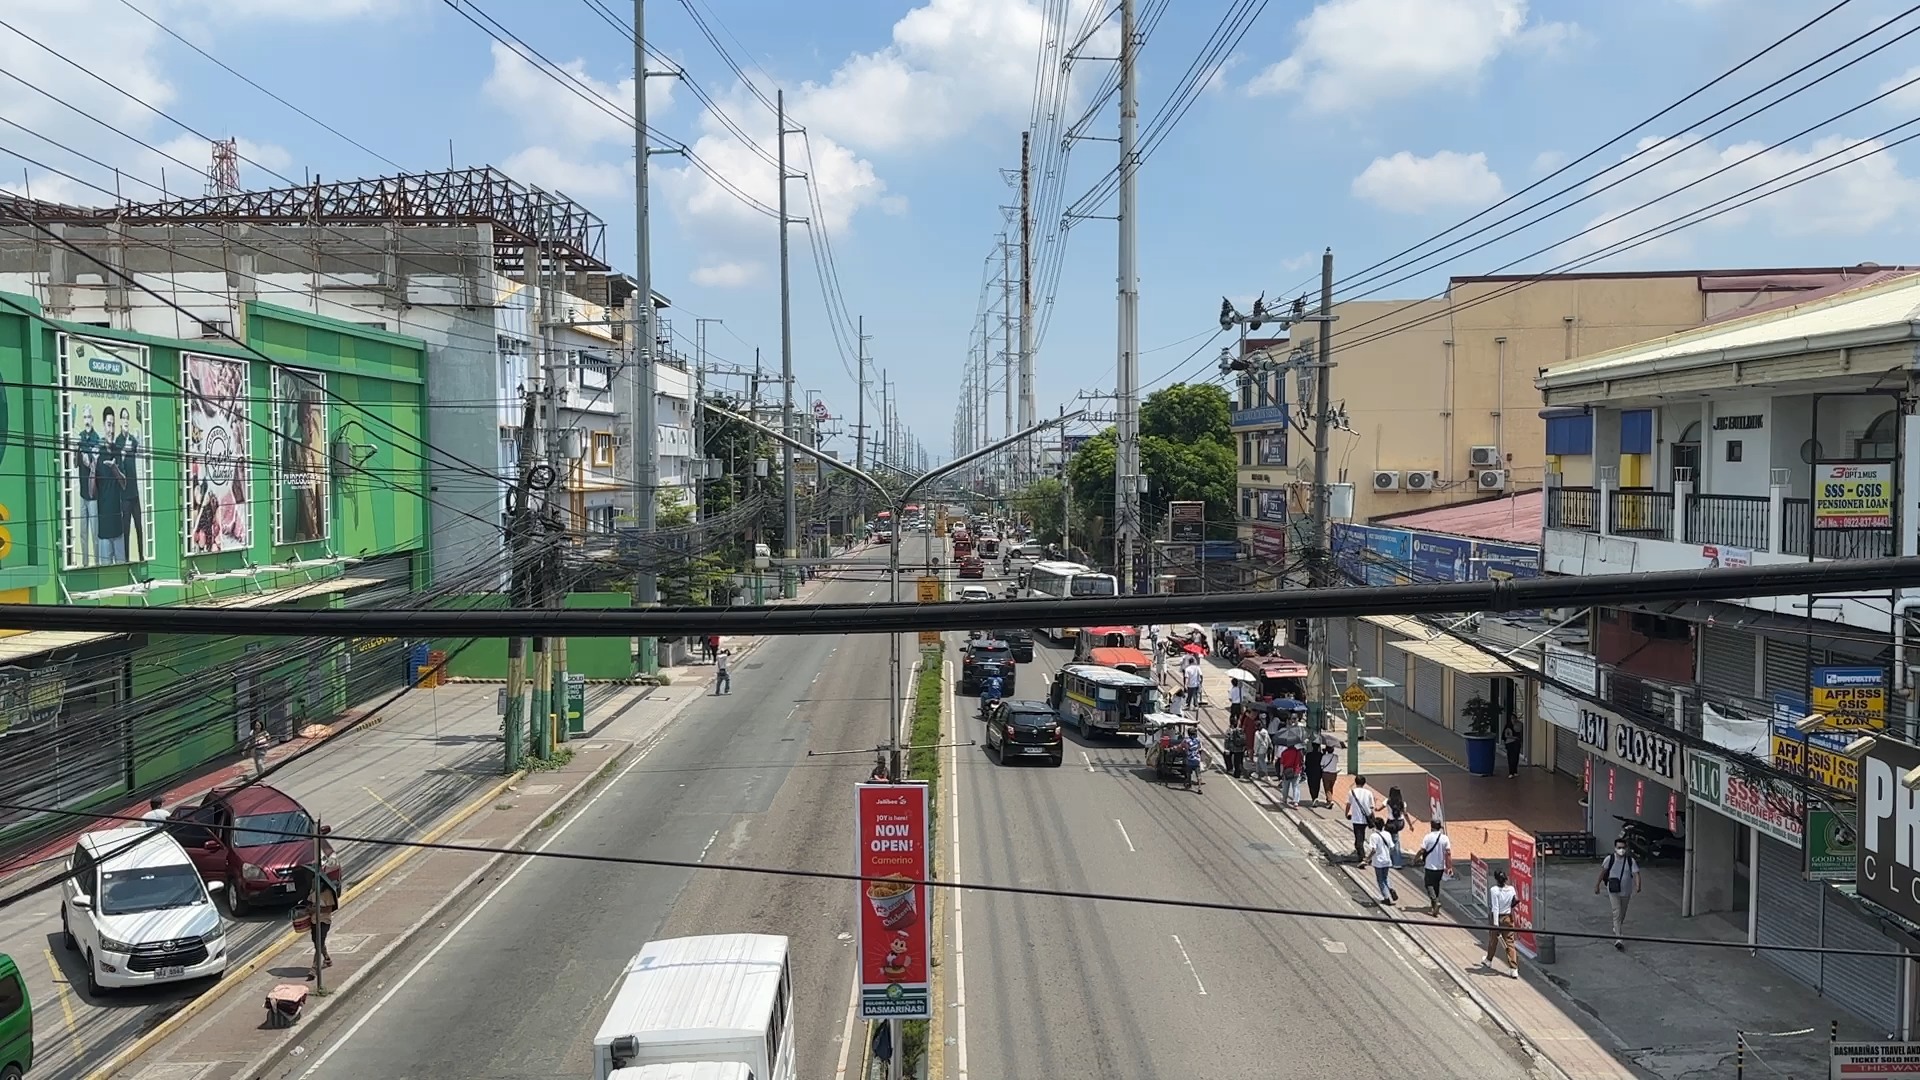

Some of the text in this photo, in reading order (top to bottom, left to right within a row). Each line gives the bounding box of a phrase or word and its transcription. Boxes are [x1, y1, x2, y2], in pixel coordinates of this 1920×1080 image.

[75, 375, 87, 386] MAS
[87, 377, 107, 389] PANALO
[107, 379, 119, 390] ANG
[1729, 414, 1764, 429] BUILDING
[1824, 483, 1845, 498] SSS
[1856, 483, 1882, 498] GSIS
[1817, 498, 1889, 509] PENSIONER LOAN
[1825, 689, 1881, 699] AFP SSS
[1838, 699, 1868, 709] GSIS
[1836, 718, 1871, 726] LOAN
[1578, 709, 1676, 779] A&M CLOSET
[1777, 740, 1799, 760] AFP
[1775, 756, 1825, 784] PENSON
[1689, 759, 1719, 800] ALC
[1727, 776, 1760, 806] SSS
[1725, 793, 1783, 827] PENSIONER'S
[1785, 817, 1803, 835] LOA
[875, 824, 909, 837] NOW
[870, 839, 913, 852] OPEN!
[871, 855, 913, 865] Camerino
[1510, 858, 1532, 878] SCHOOL
[865, 1004, 925, 1014] DASMARIÑAS!
[1834, 1044, 1880, 1056] DASMARIÑAS
[1881, 1045, 1906, 1056] TRAVEL
